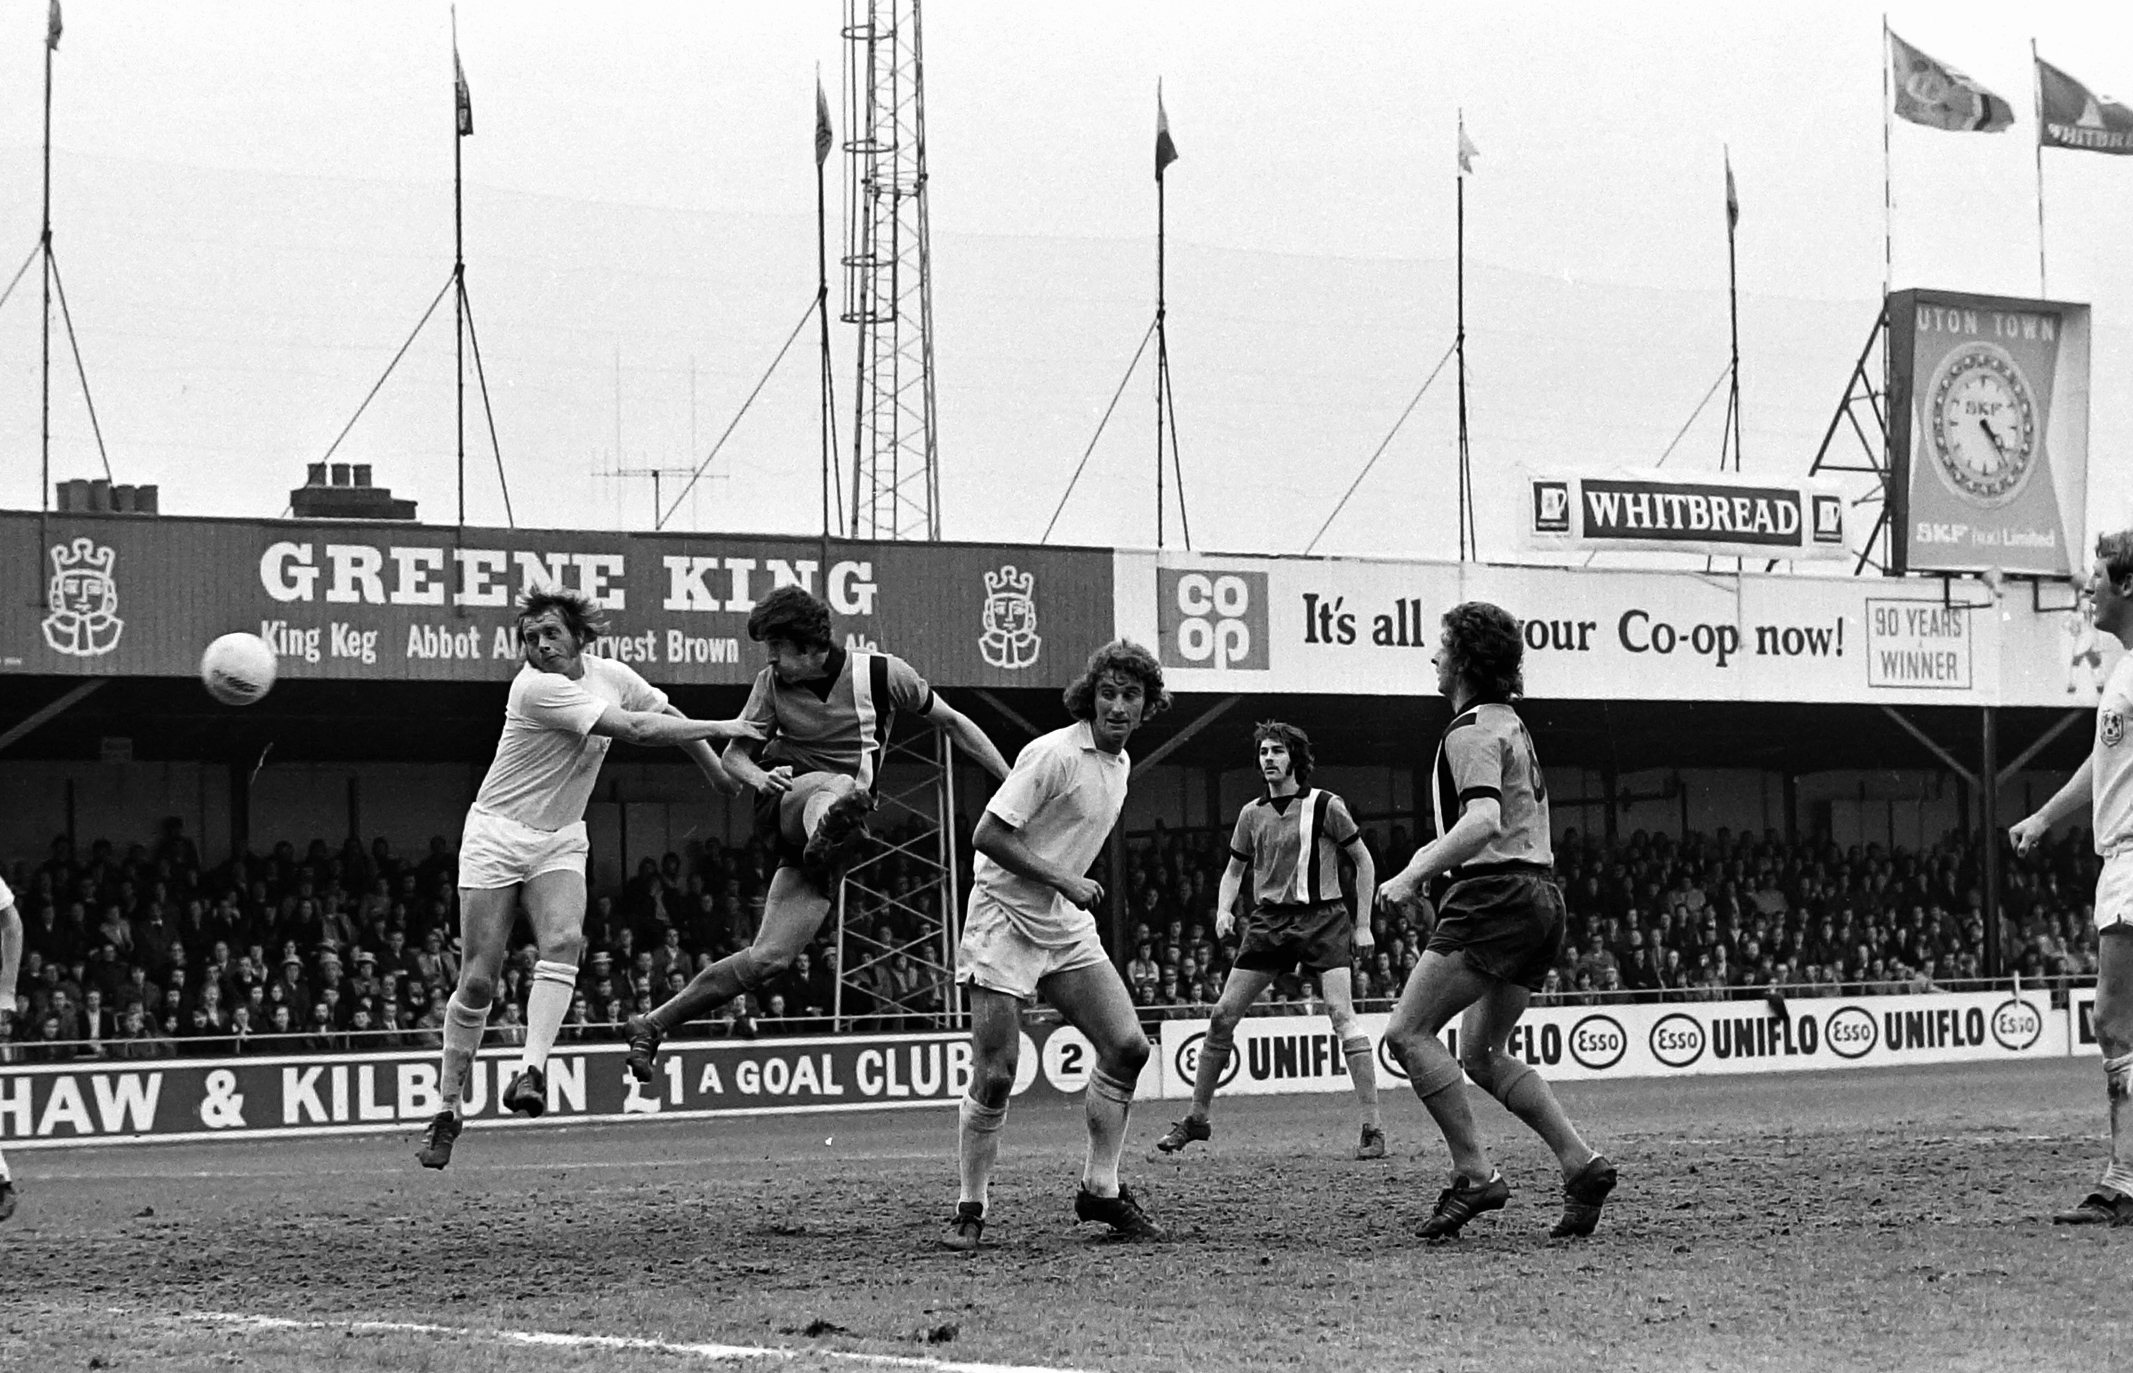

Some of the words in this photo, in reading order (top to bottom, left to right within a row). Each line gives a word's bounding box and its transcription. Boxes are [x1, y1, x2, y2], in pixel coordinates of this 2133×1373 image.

[1916, 307, 1978, 334] UTON
[1992, 311, 2055, 341] TOWN
[1586, 491, 1799, 535] WHITBREAD
[1916, 521, 1969, 543] SKF
[260, 541, 626, 610] GREENE
[663, 556, 878, 616] KING
[261, 620, 321, 663] King
[331, 622, 378, 664] Keg
[406, 625, 481, 660] Abbot
[493, 626, 517, 660] Al
[583, 630, 658, 662] arvest
[667, 630, 740, 664] Brown
[1302, 593, 1356, 645] It's
[1372, 598, 1425, 647] all
[1518, 620, 1597, 651] our
[1618, 609, 1739, 667] Co-op
[1755, 616, 1843, 657] now!
[1875, 607, 1899, 637] 90
[1906, 608, 1962, 638] YEARS
[1881, 650, 1958, 681] WINNER
[1061, 1043, 1083, 1074] 2
[1248, 1034, 1347, 1080] UNIFL
[1713, 1015, 1818, 1059] UNIFLO
[1885, 1007, 1985, 1051] UNIFLO
[623, 1056, 684, 1114] £1
[699, 1063, 724, 1094] A
[736, 1054, 844, 1095] GOAL
[856, 1041, 974, 1097] CLUB
[0, 1072, 163, 1137] HAW
[201, 1069, 247, 1128] &
